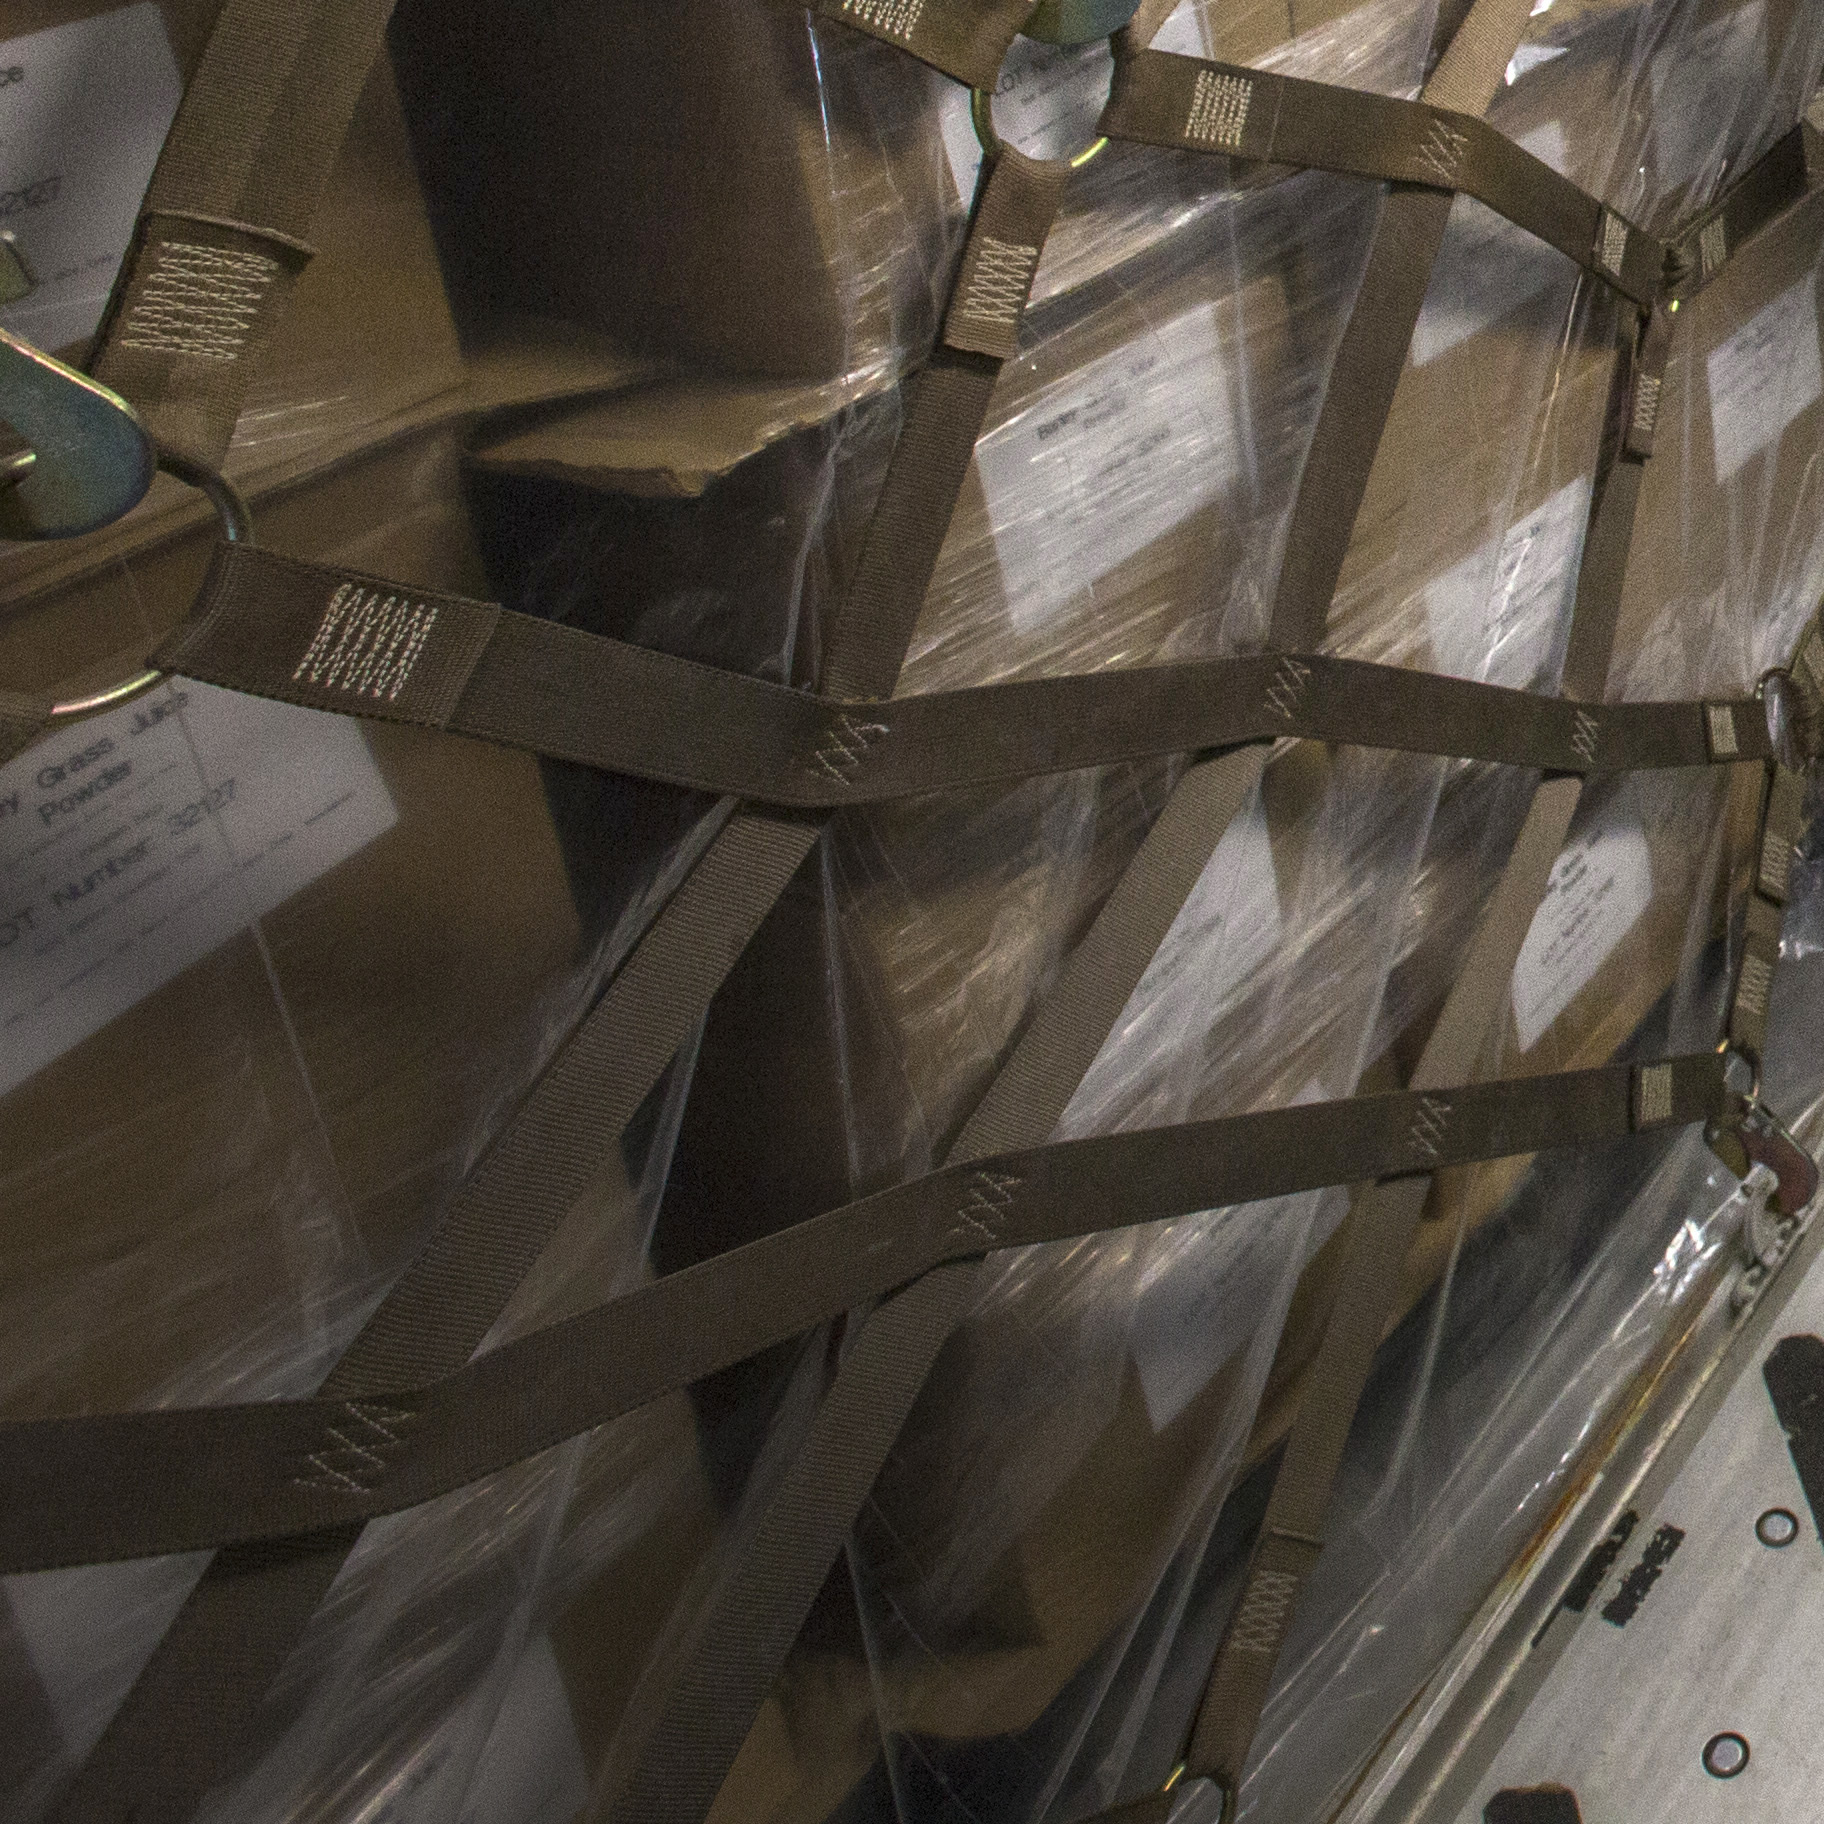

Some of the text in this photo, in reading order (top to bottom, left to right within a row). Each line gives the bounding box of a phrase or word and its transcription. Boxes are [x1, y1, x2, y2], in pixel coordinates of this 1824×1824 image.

[36, 737, 116, 789] Grass
[39, 760, 133, 827] Powder
[53, 839, 150, 906] Number
